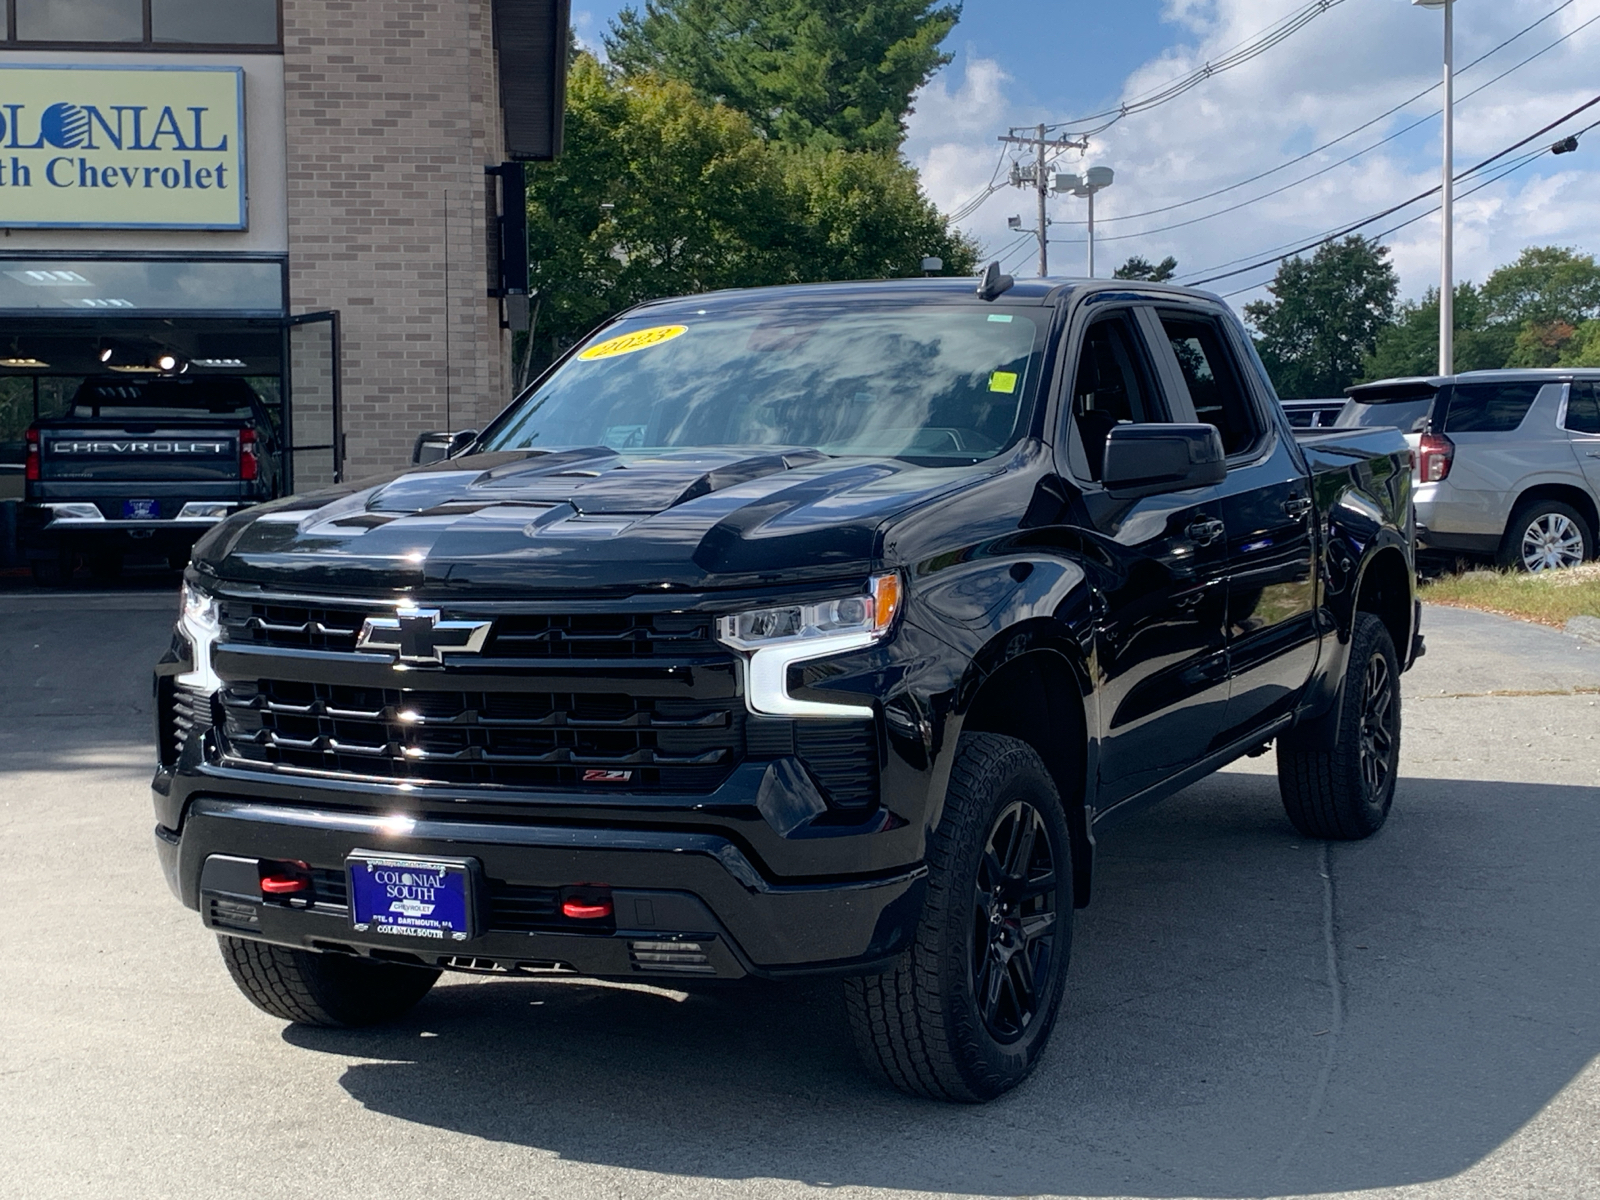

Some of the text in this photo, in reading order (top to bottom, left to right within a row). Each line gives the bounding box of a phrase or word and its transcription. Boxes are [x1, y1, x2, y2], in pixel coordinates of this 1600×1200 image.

[0, 102, 228, 151] LONIAL
[46, 157, 228, 189] Chevrolet
[594, 328, 672, 357] 2023
[53, 443, 226, 453] CHEVROLET
[583, 770, 632, 781] Z71
[375, 871, 445, 888] COLONIAL
[387, 885, 435, 900] SOUTH
[393, 903, 431, 912] CHEVROLET
[377, 925, 444, 938] COLONIAL SOUTH
